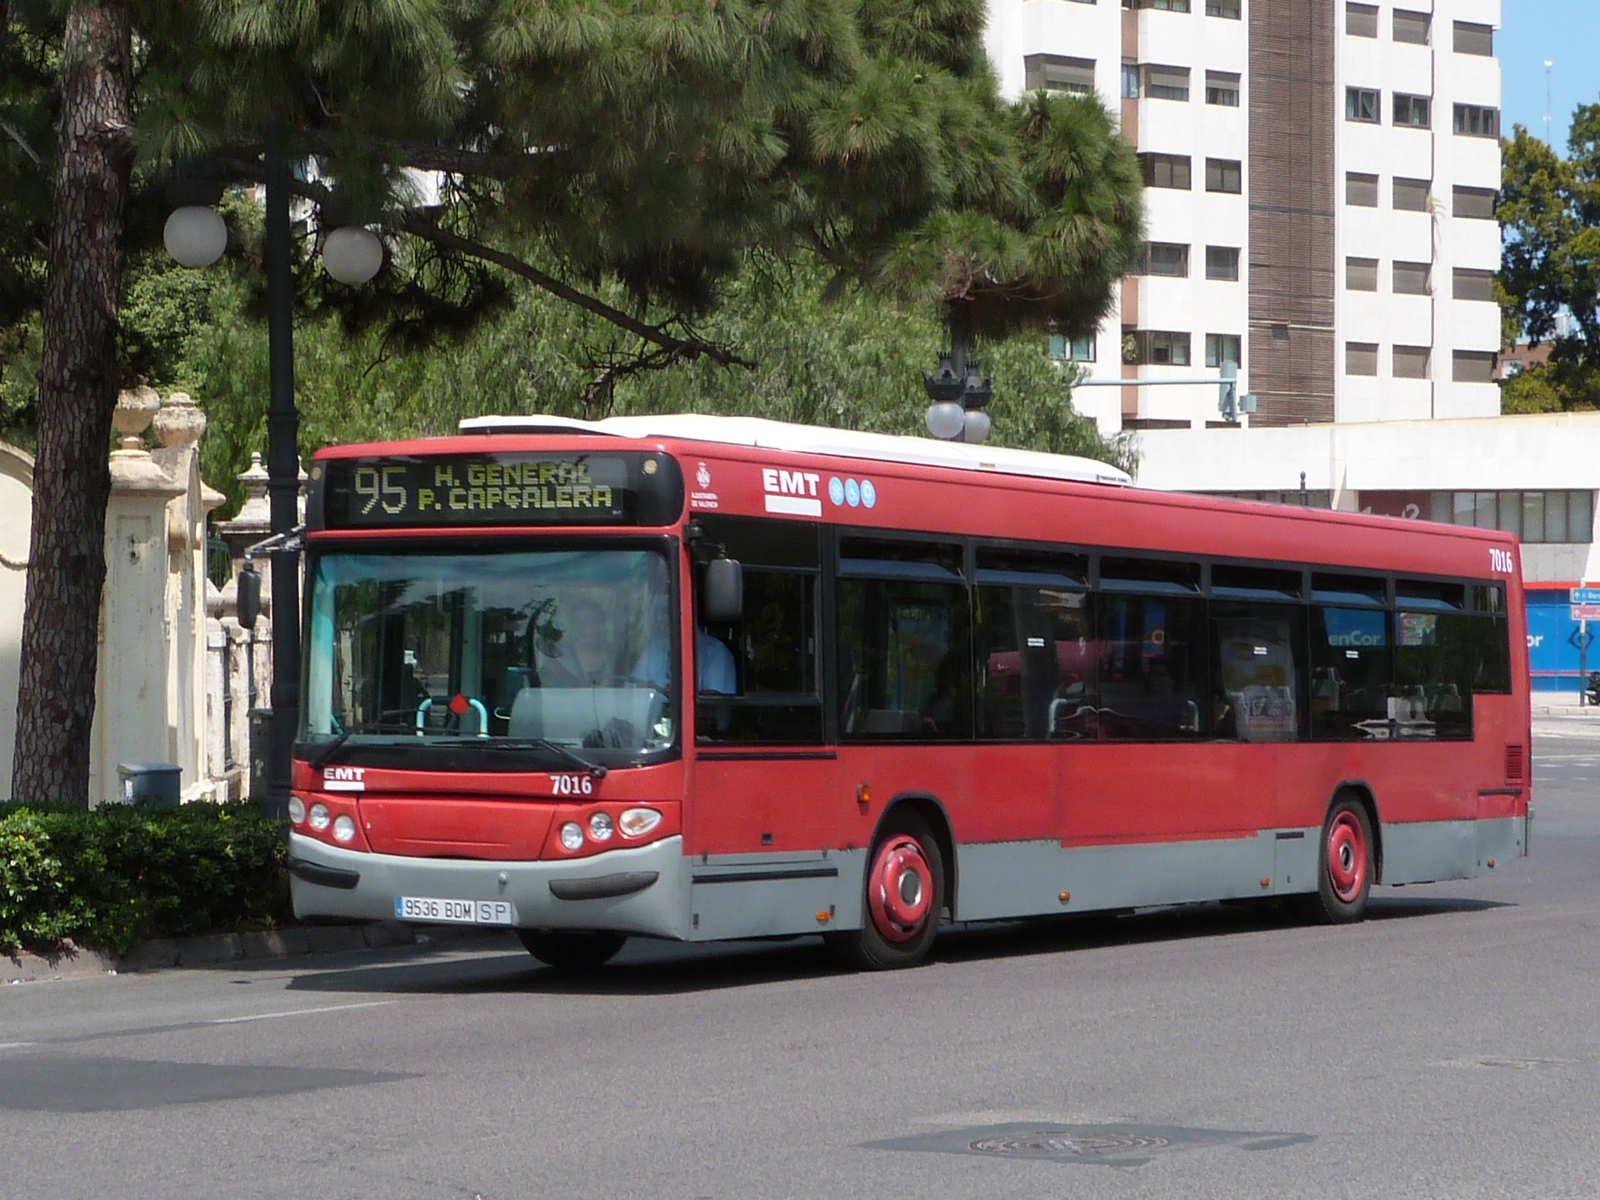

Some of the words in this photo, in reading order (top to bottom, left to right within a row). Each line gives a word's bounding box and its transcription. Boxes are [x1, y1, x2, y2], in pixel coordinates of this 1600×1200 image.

[435, 465, 460, 486] H.
[468, 462, 592, 486] GENERAL
[762, 468, 820, 496] EMT
[355, 466, 407, 514] 95
[418, 488, 442, 510] P.
[1489, 548, 1513, 573] 7016
[323, 767, 365, 781] EMT
[551, 774, 593, 796] 7016
[405, 899, 439, 917] 9536
[445, 901, 473, 920] BDM
